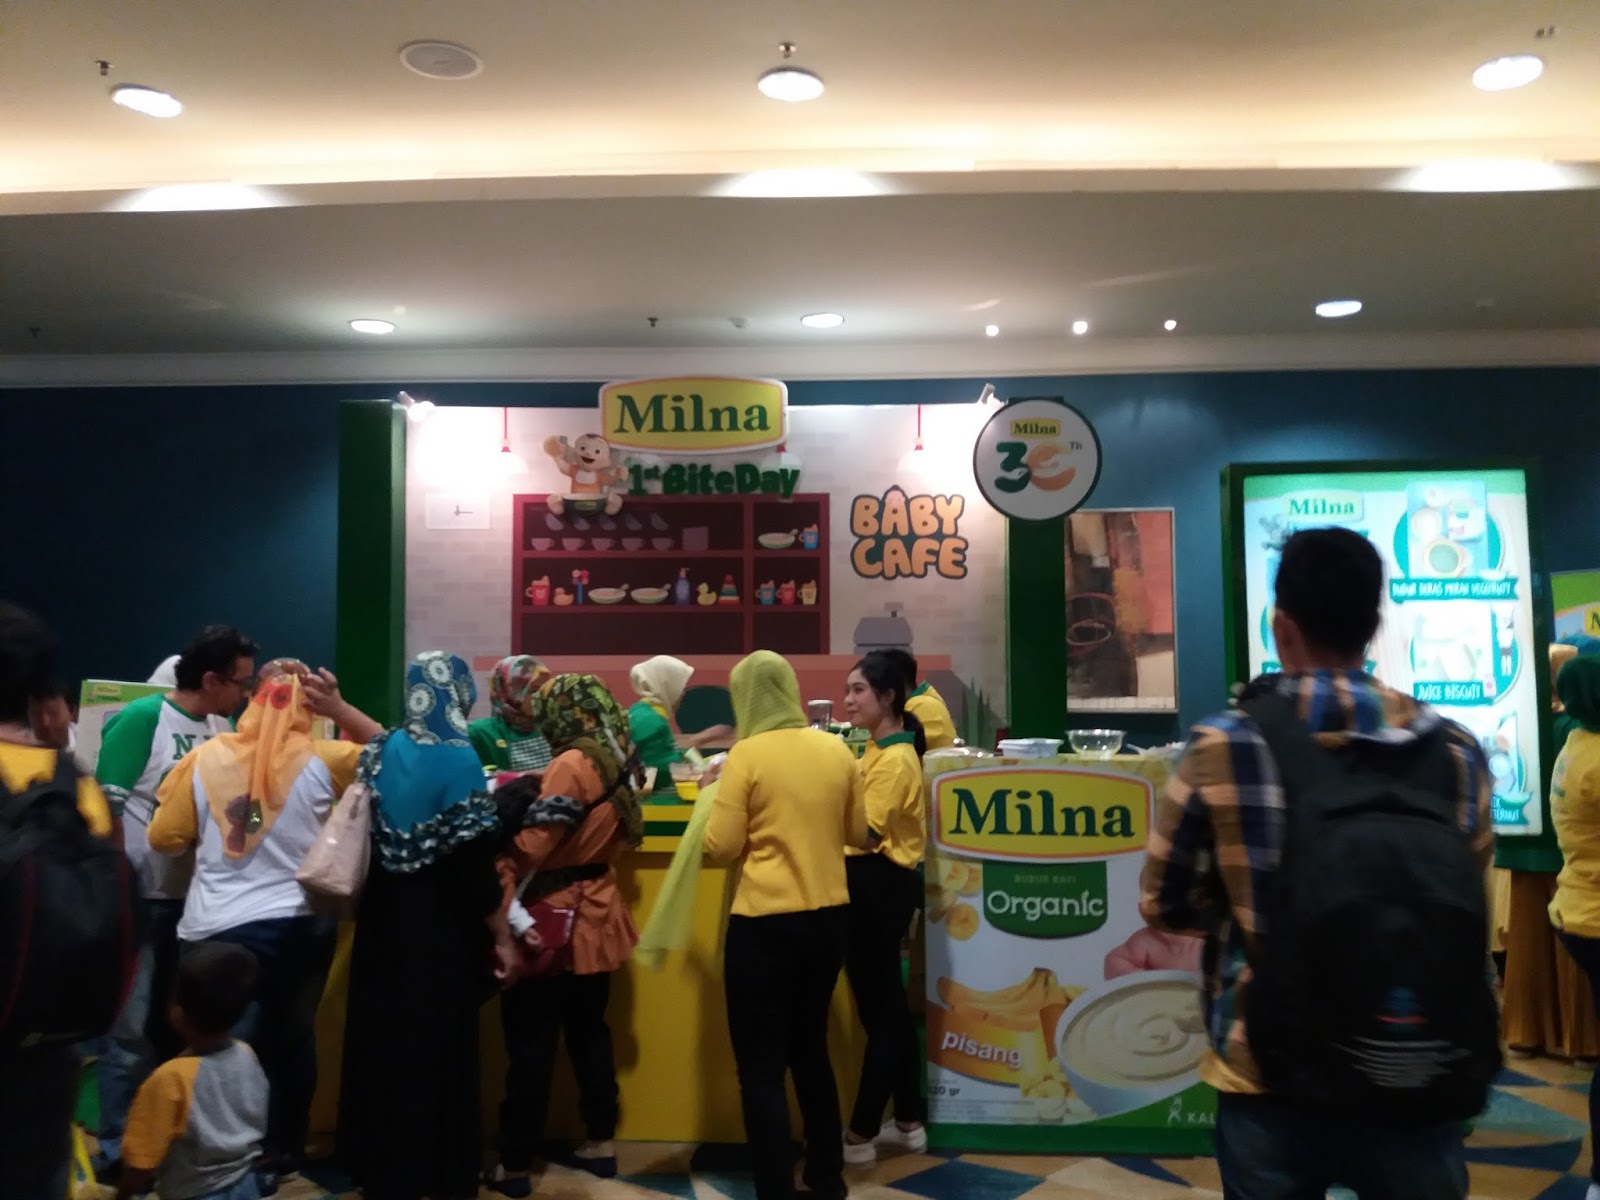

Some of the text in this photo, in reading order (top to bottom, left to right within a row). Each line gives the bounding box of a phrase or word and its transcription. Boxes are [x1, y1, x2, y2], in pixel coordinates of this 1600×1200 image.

[614, 394, 771, 433] Milna
[1014, 422, 1057, 435] Milna
[850, 485, 965, 538] BABY
[1289, 498, 1354, 515] Milna
[850, 536, 968, 580] CAFE
[949, 788, 1136, 838] Milna
[987, 890, 1105, 921] Organic
[941, 1031, 1024, 1069] pisang
[1187, 1111, 1217, 1124] KAL
